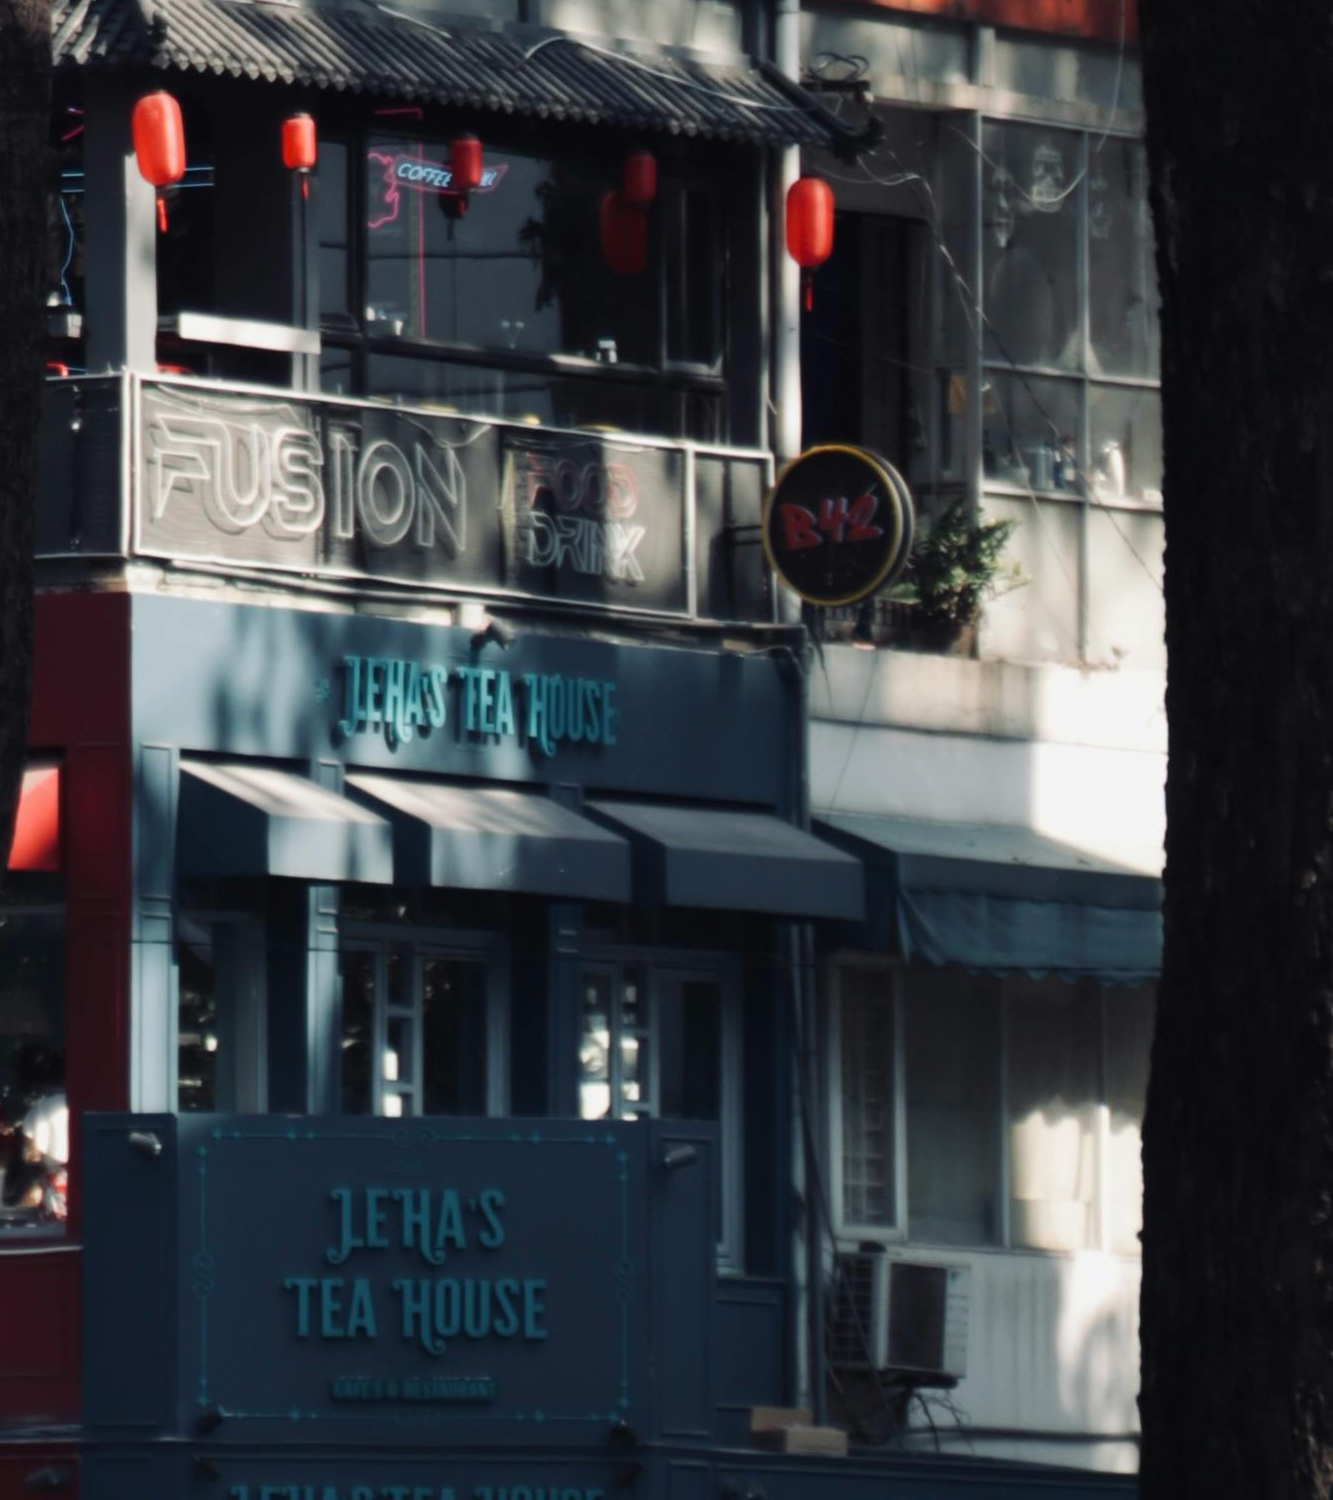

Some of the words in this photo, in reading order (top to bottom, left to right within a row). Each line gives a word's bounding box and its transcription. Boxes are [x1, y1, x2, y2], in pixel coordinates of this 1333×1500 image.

[148, 412, 467, 554] FUSION
[527, 451, 638, 518] FOOD
[779, 493, 884, 551] B42
[525, 511, 646, 582] DRINK
[457, 666, 516, 736] TEA
[523, 672, 618, 758] HOUSE
[323, 1186, 508, 1267] LEHA'S
[283, 1276, 378, 1340] TEA
[391, 1276, 550, 1357] HOUSE
